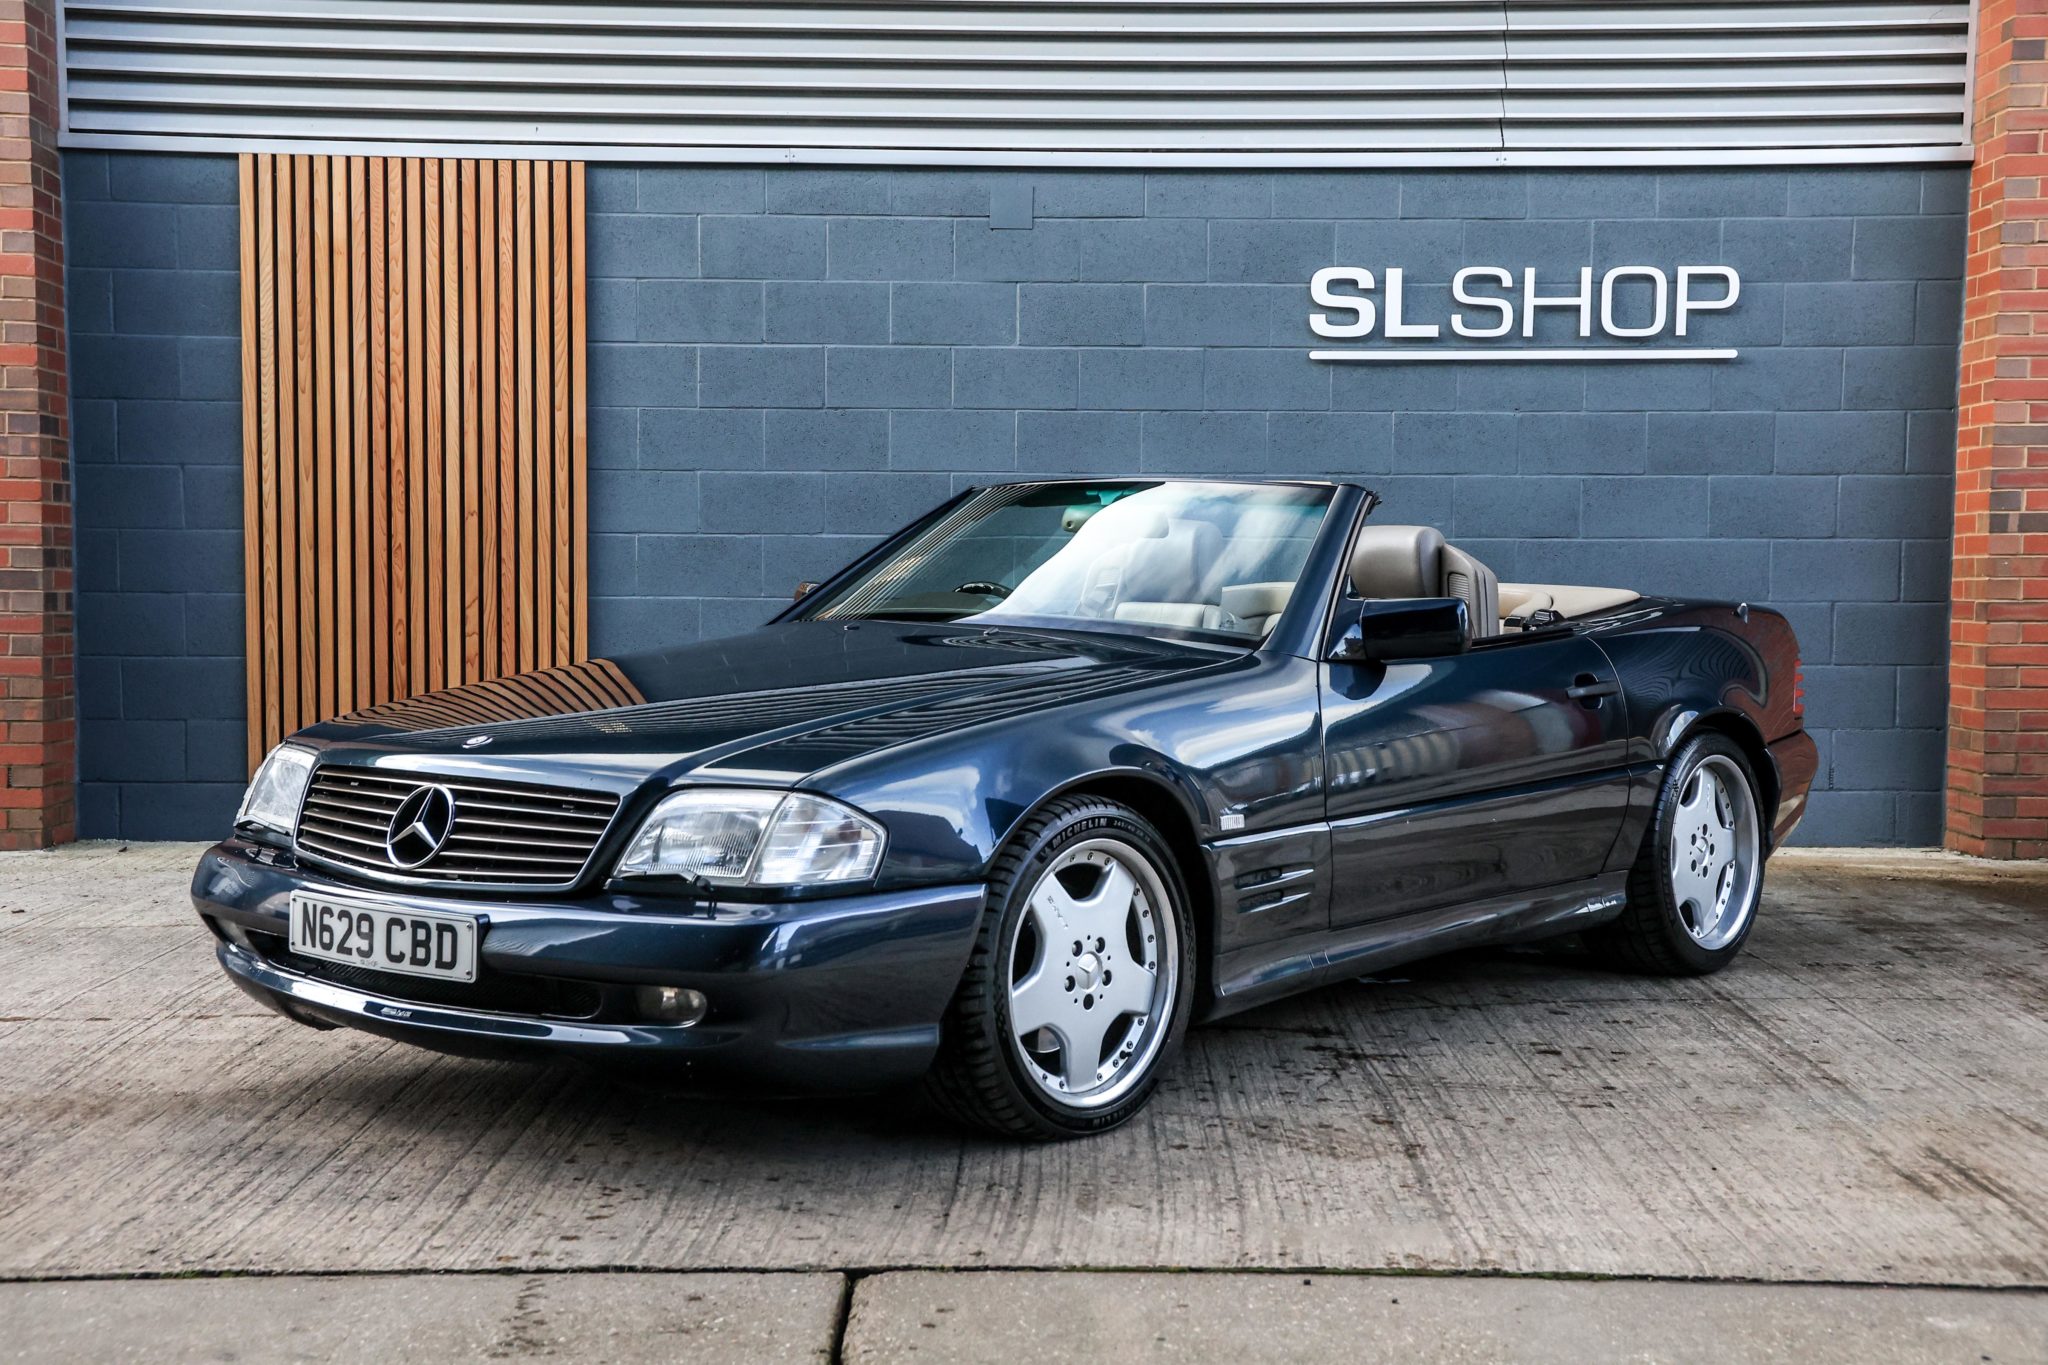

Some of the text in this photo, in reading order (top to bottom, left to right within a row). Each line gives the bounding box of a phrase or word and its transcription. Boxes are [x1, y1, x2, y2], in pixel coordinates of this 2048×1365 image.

[1053, 818, 1108, 847] MICHELIN
[302, 902, 458, 970] N629 CBD
